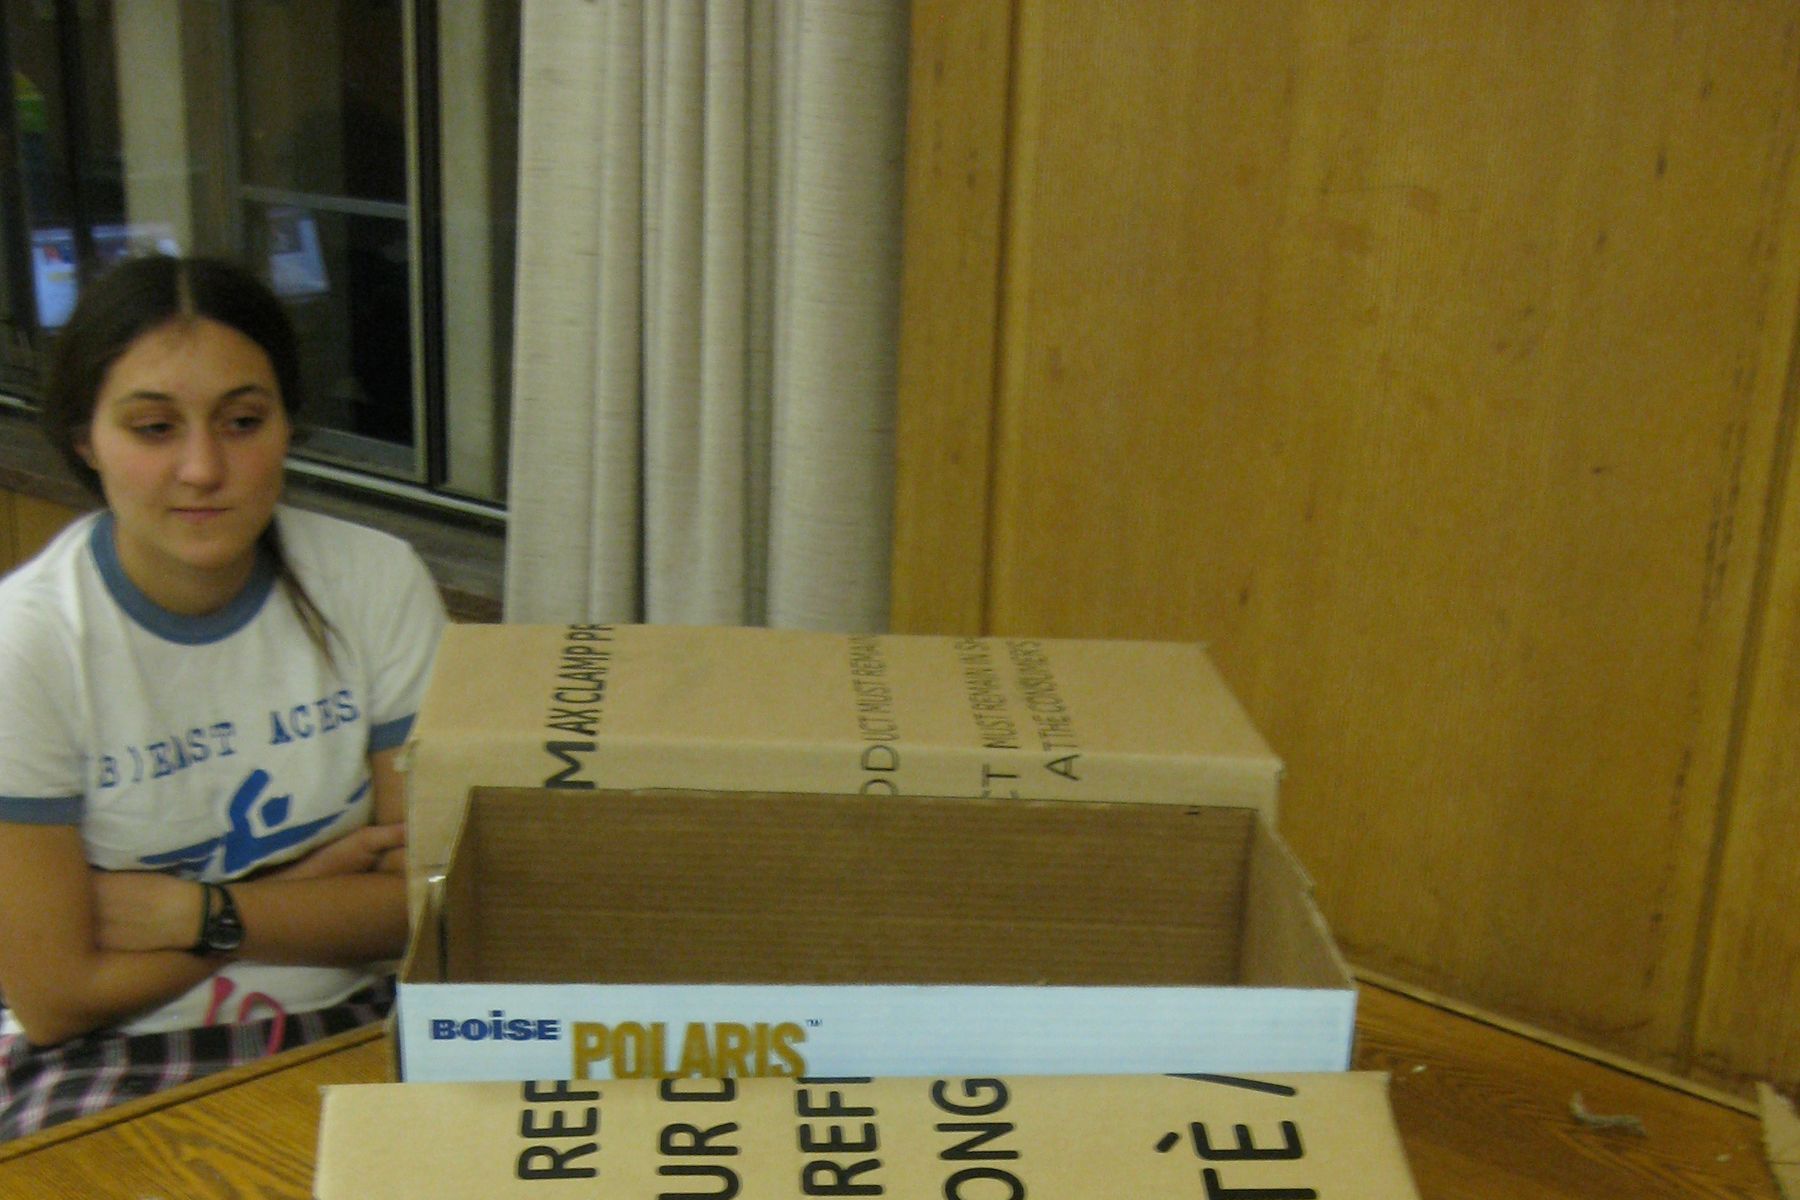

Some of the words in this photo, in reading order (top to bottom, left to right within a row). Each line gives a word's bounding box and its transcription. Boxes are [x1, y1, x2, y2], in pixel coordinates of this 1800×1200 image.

[554, 645, 612, 704] CLAMP
[268, 689, 361, 745] ACES
[545, 707, 603, 789] MAX
[570, 1020, 807, 1080] POLARIS
